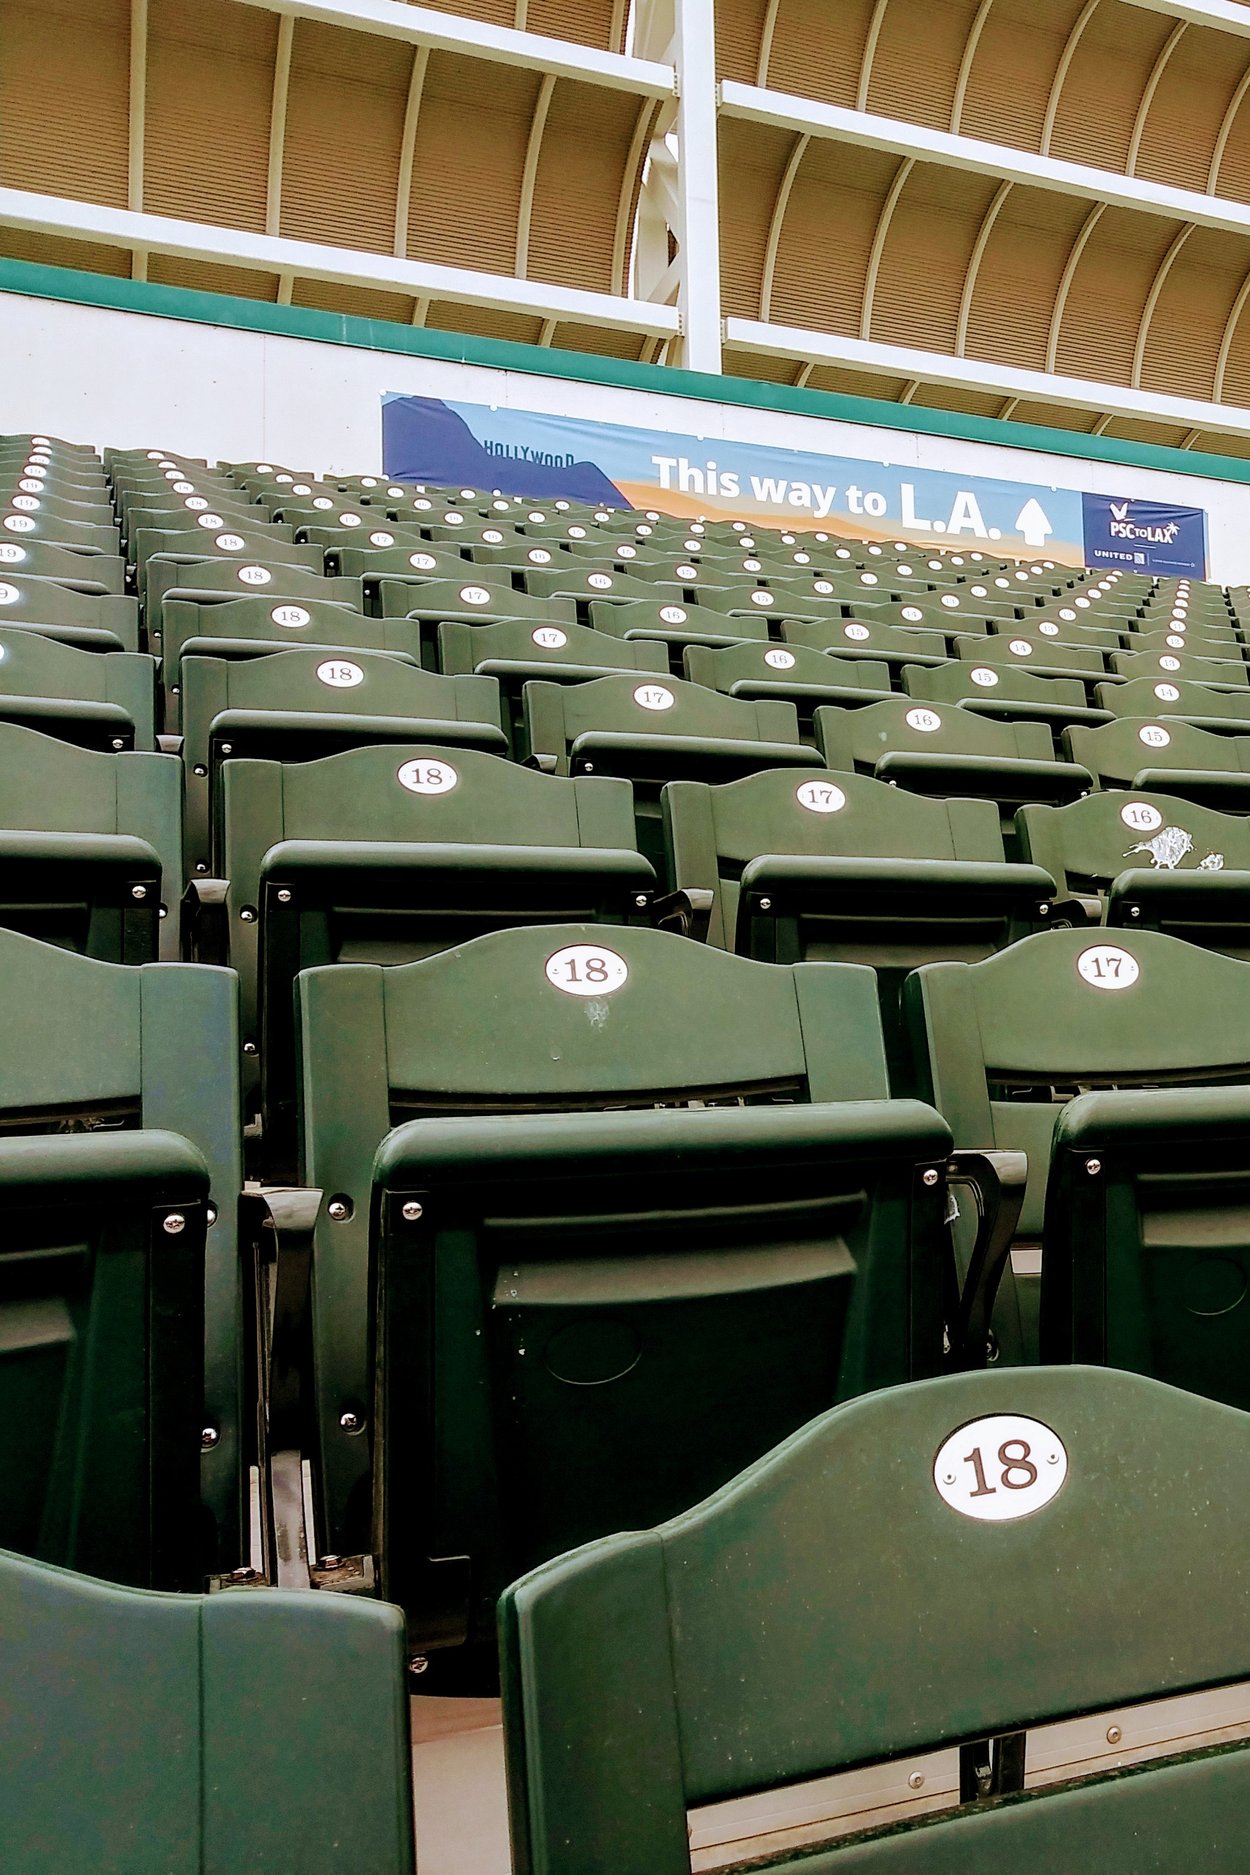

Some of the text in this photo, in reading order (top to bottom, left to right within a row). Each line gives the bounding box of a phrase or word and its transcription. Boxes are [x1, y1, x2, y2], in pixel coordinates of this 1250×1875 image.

[484, 440, 575, 467] HOLLYWOOD
[651, 456, 1001, 541] This way to L.A.
[1094, 549, 1133, 561] UNITED
[0, 587, 9, 599] 9
[281, 611, 301, 622] 18
[541, 632, 558, 643] 17
[772, 654, 788, 664] 16
[329, 667, 353, 681] 18
[644, 691, 664, 704] 17
[914, 714, 933, 726] 16
[1146, 731, 1163, 743] 15
[411, 768, 443, 786] 18
[808, 789, 833, 805] 17
[1130, 809, 1153, 824] 16
[564, 957, 609, 983] 18
[1091, 957, 1122, 978] 17
[964, 1439, 1037, 1497] 18
